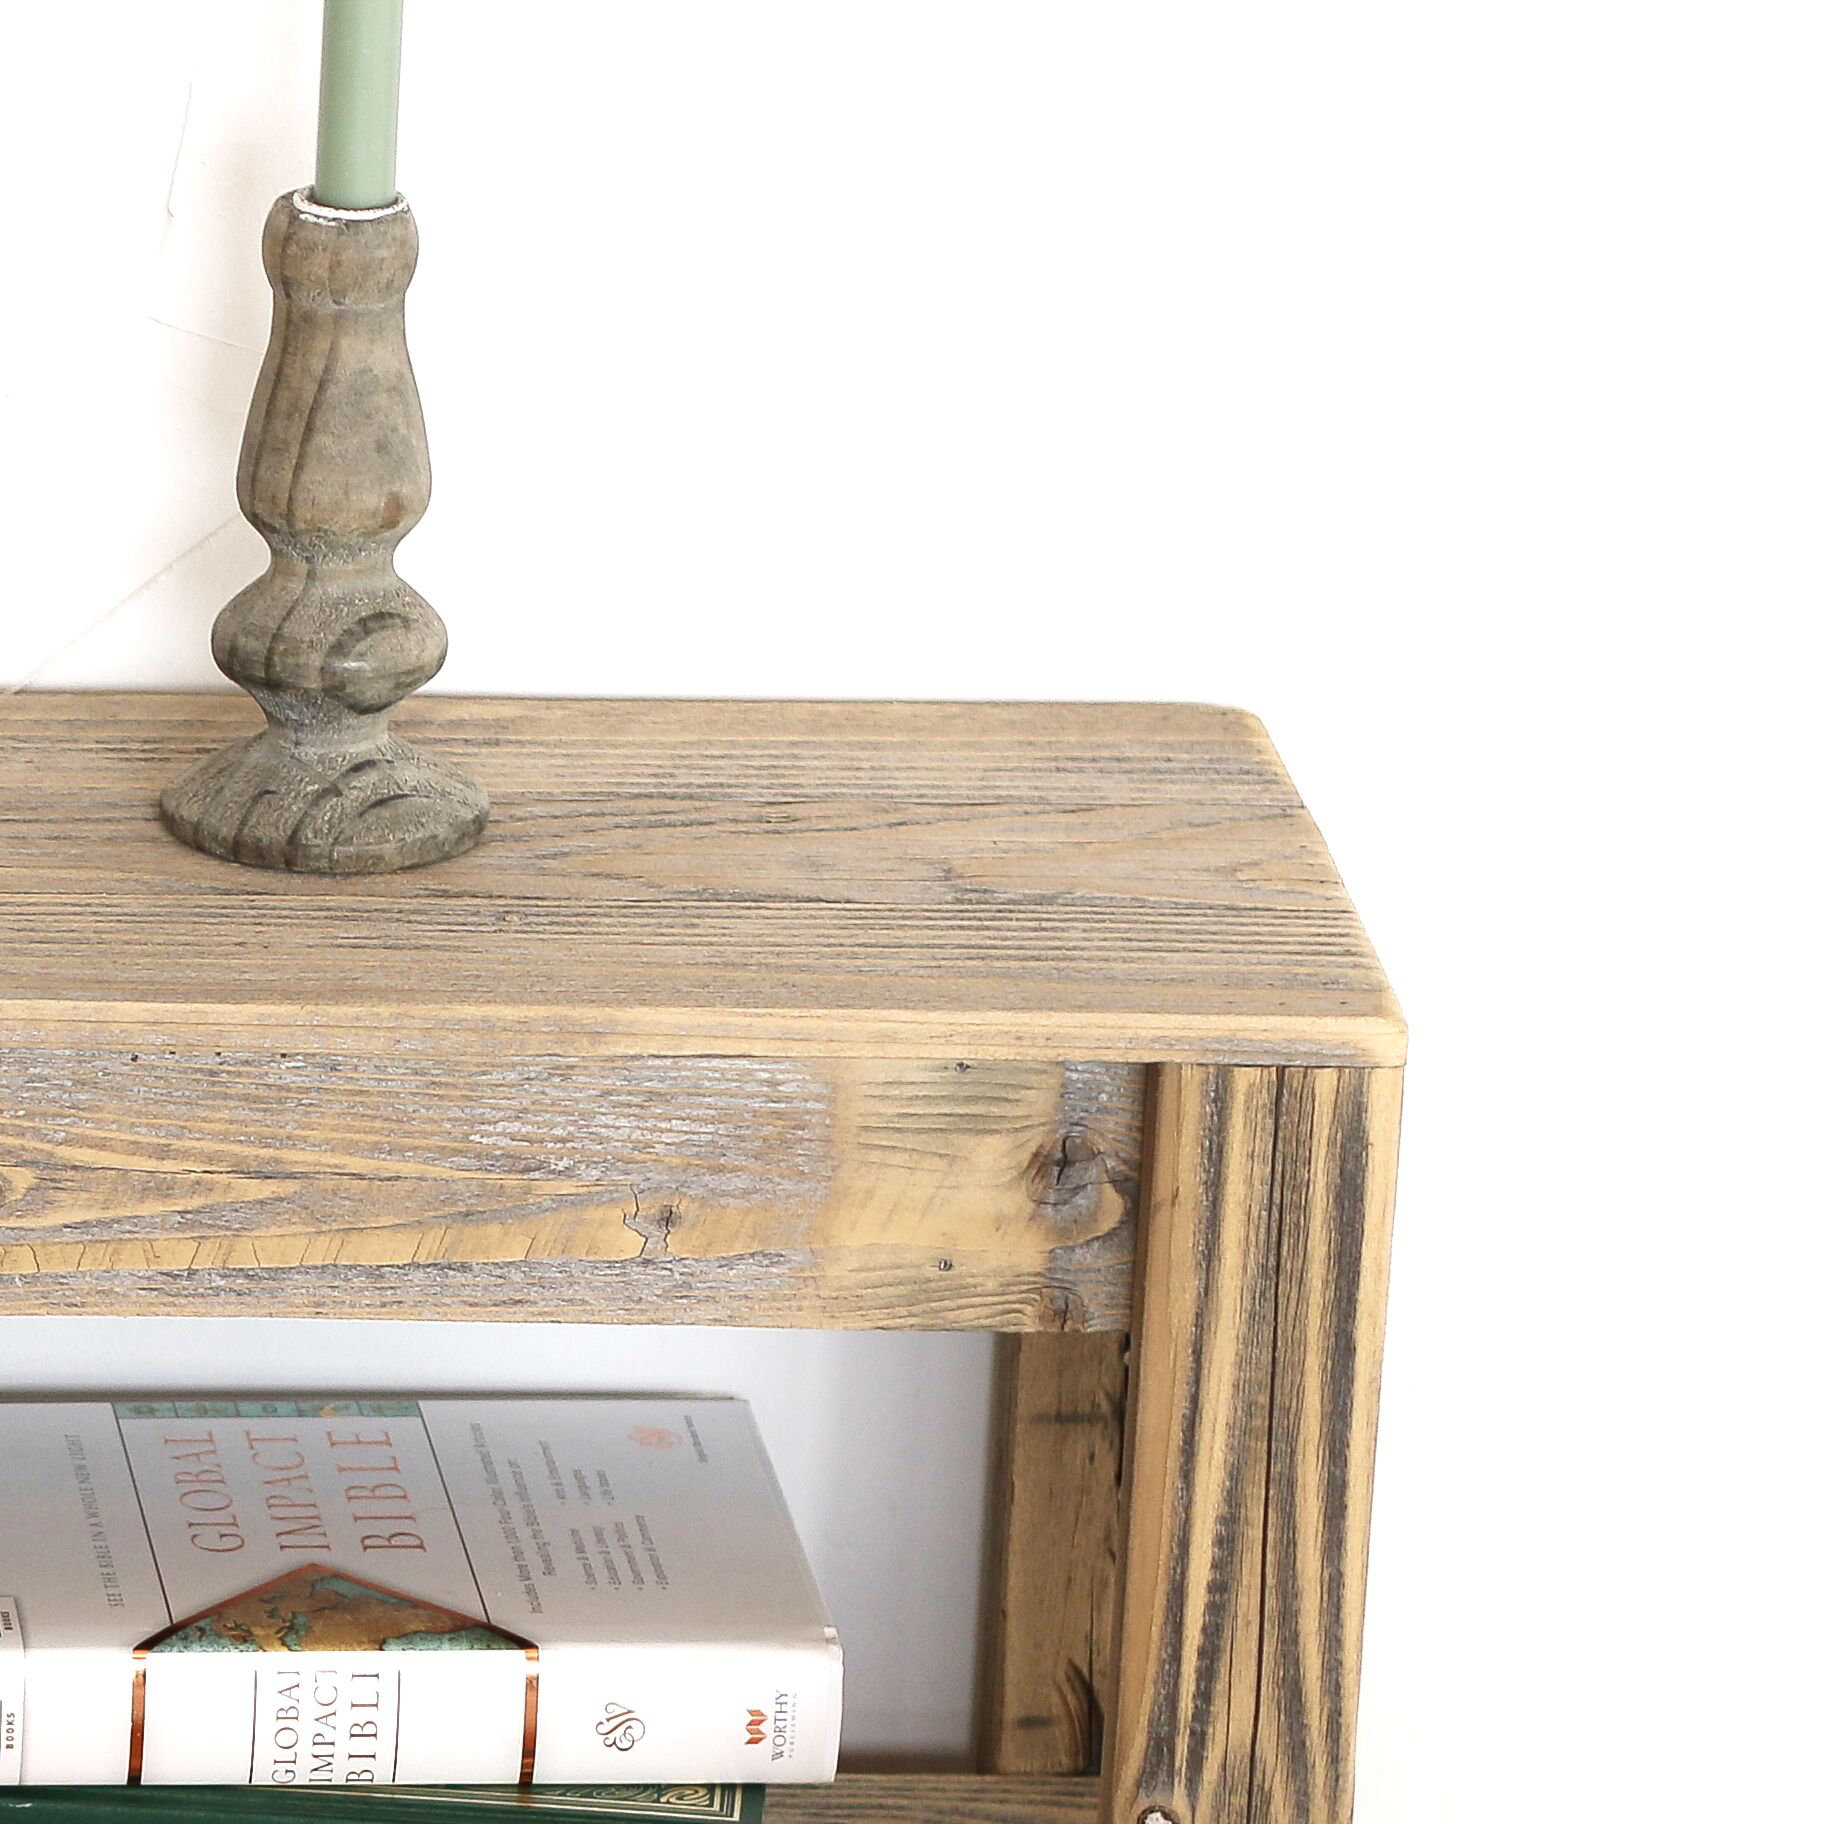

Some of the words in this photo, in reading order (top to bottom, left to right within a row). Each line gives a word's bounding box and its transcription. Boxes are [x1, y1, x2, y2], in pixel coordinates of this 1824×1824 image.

[63, 1432, 88, 1460] LIGHT
[72, 1462, 94, 1485] NEW
[78, 1487, 101, 1519] WHOLE
[163, 1430, 246, 1553] GLOBAL
[245, 1429, 332, 1552] IMPACT
[326, 1430, 428, 1553] BIBLE
[87, 1520, 104, 1529] A
[89, 1530, 107, 1542] IN
[93, 1544, 115, 1569] BIBLE
[100, 1572, 121, 1589] THE
[106, 1592, 126, 1608] SEE
[5, 1712, 16, 1750] BOOKS
[308, 1669, 338, 1783] IMPACT
[771, 1688, 789, 1762] WORTHY
